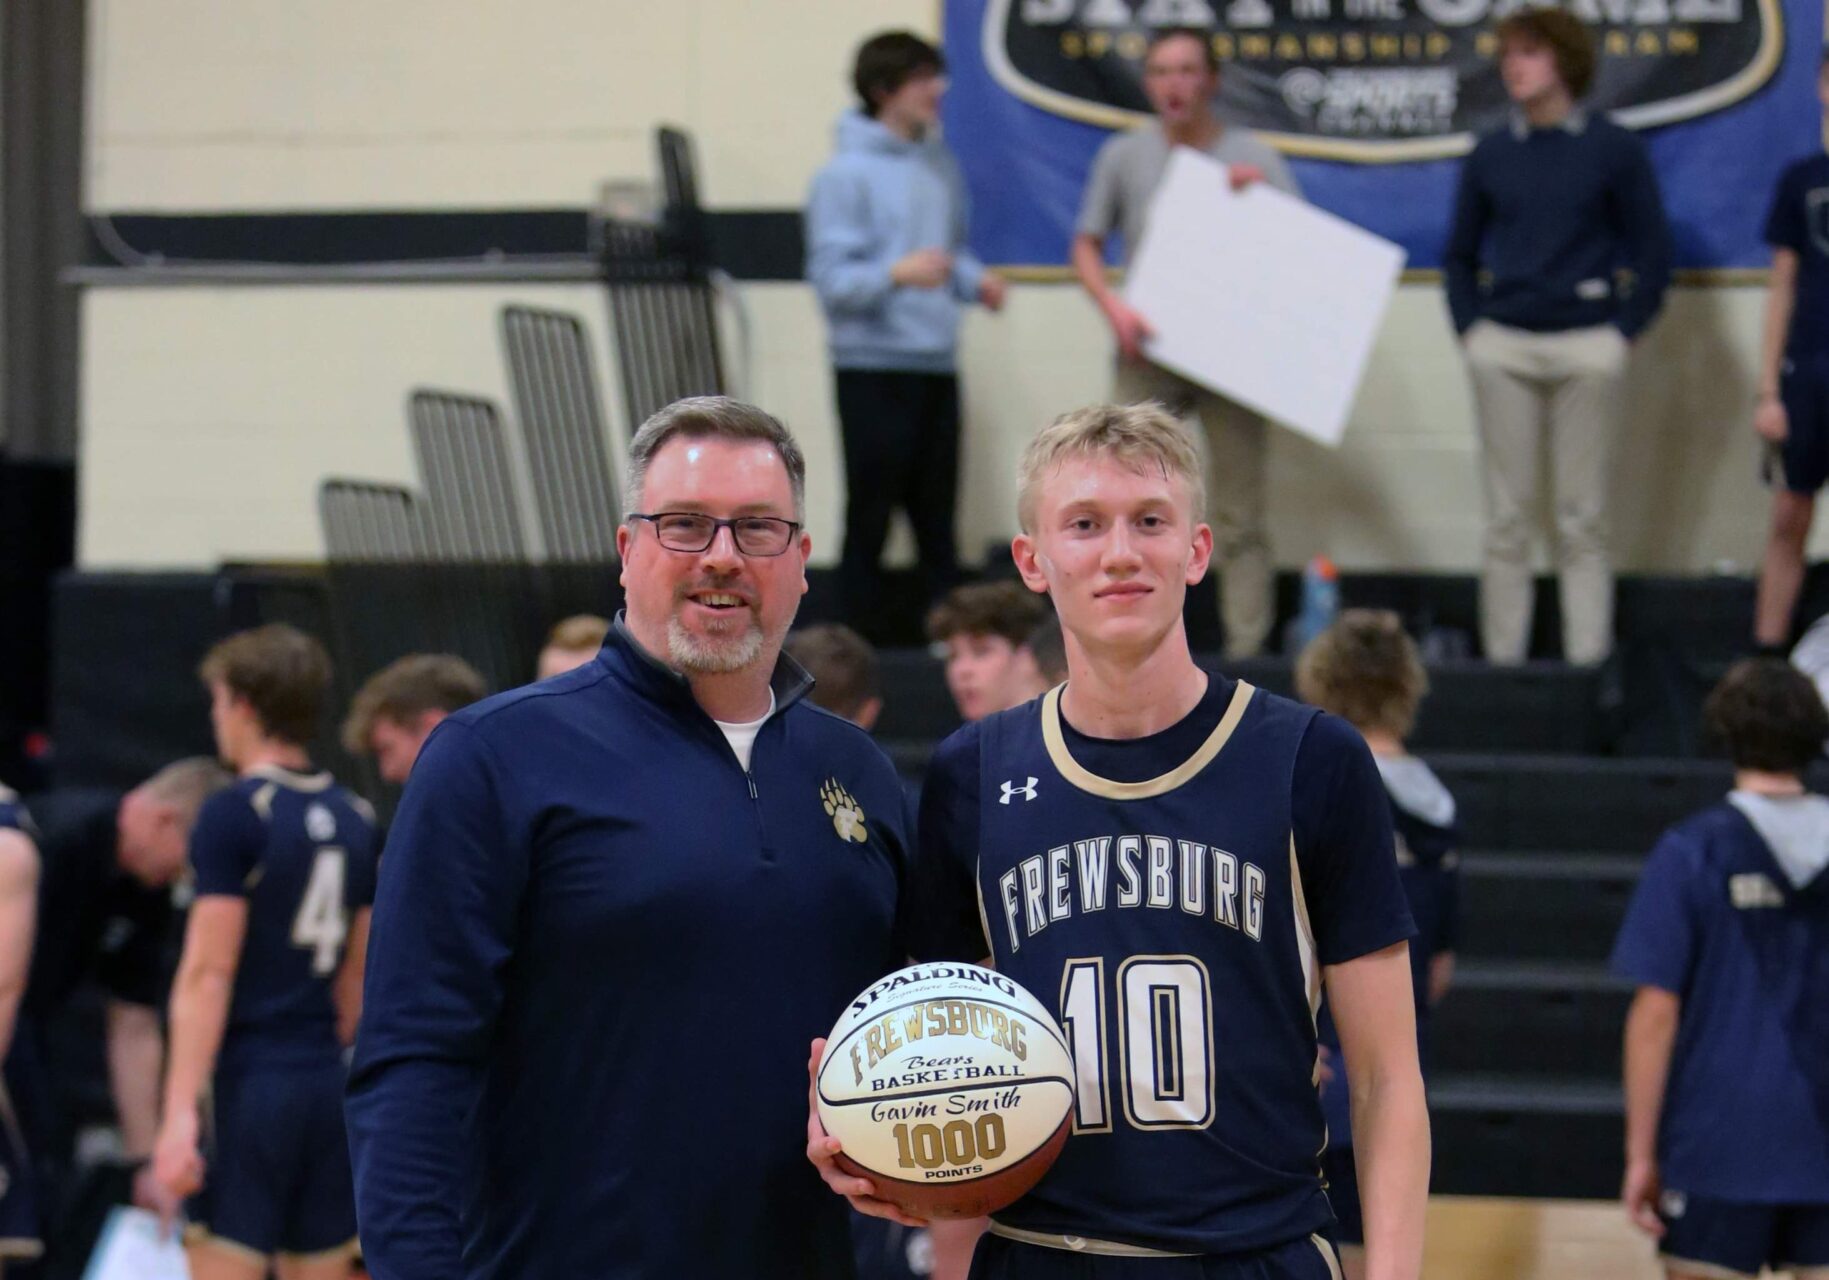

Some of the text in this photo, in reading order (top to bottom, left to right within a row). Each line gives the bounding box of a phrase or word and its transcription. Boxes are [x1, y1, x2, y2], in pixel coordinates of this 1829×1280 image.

[1059, 30, 1450, 61] SPOSMANSHIP
[291, 847, 348, 974] 4
[1000, 835, 1266, 953] FREWSBURG
[852, 967, 1017, 1019] SPALDING
[850, 1001, 1027, 1087] FREWSBURG
[901, 1056, 975, 1070] Bears
[1060, 954, 1216, 1135] 10
[872, 1064, 1026, 1092] BASKETBALL
[871, 1086, 1022, 1123] Gavin Smith
[892, 1112, 1007, 1169] 1000
[925, 1164, 984, 1179] POINTS
